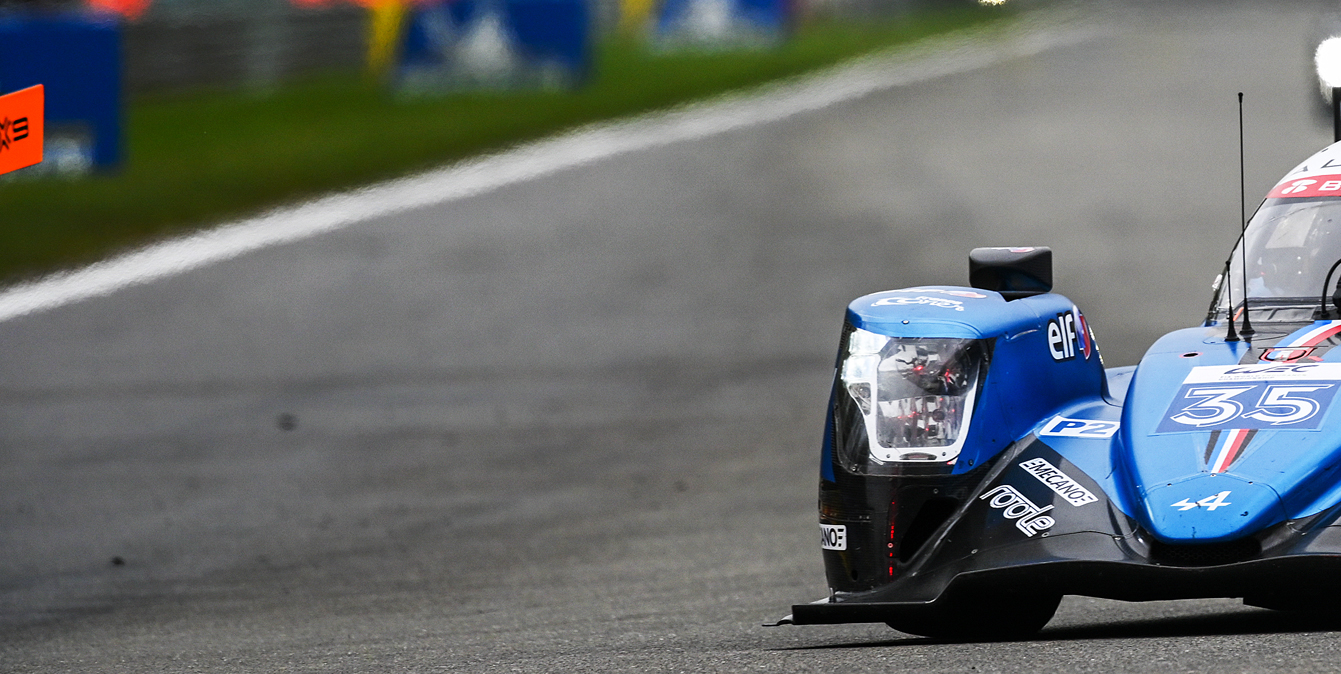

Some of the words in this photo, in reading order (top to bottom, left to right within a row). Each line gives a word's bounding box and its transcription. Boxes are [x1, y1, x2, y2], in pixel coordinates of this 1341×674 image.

[1047, 312, 1075, 361] elf
[1224, 364, 1320, 375] WEC
[1170, 384, 1336, 428] 35
[1049, 420, 1116, 435] P2
